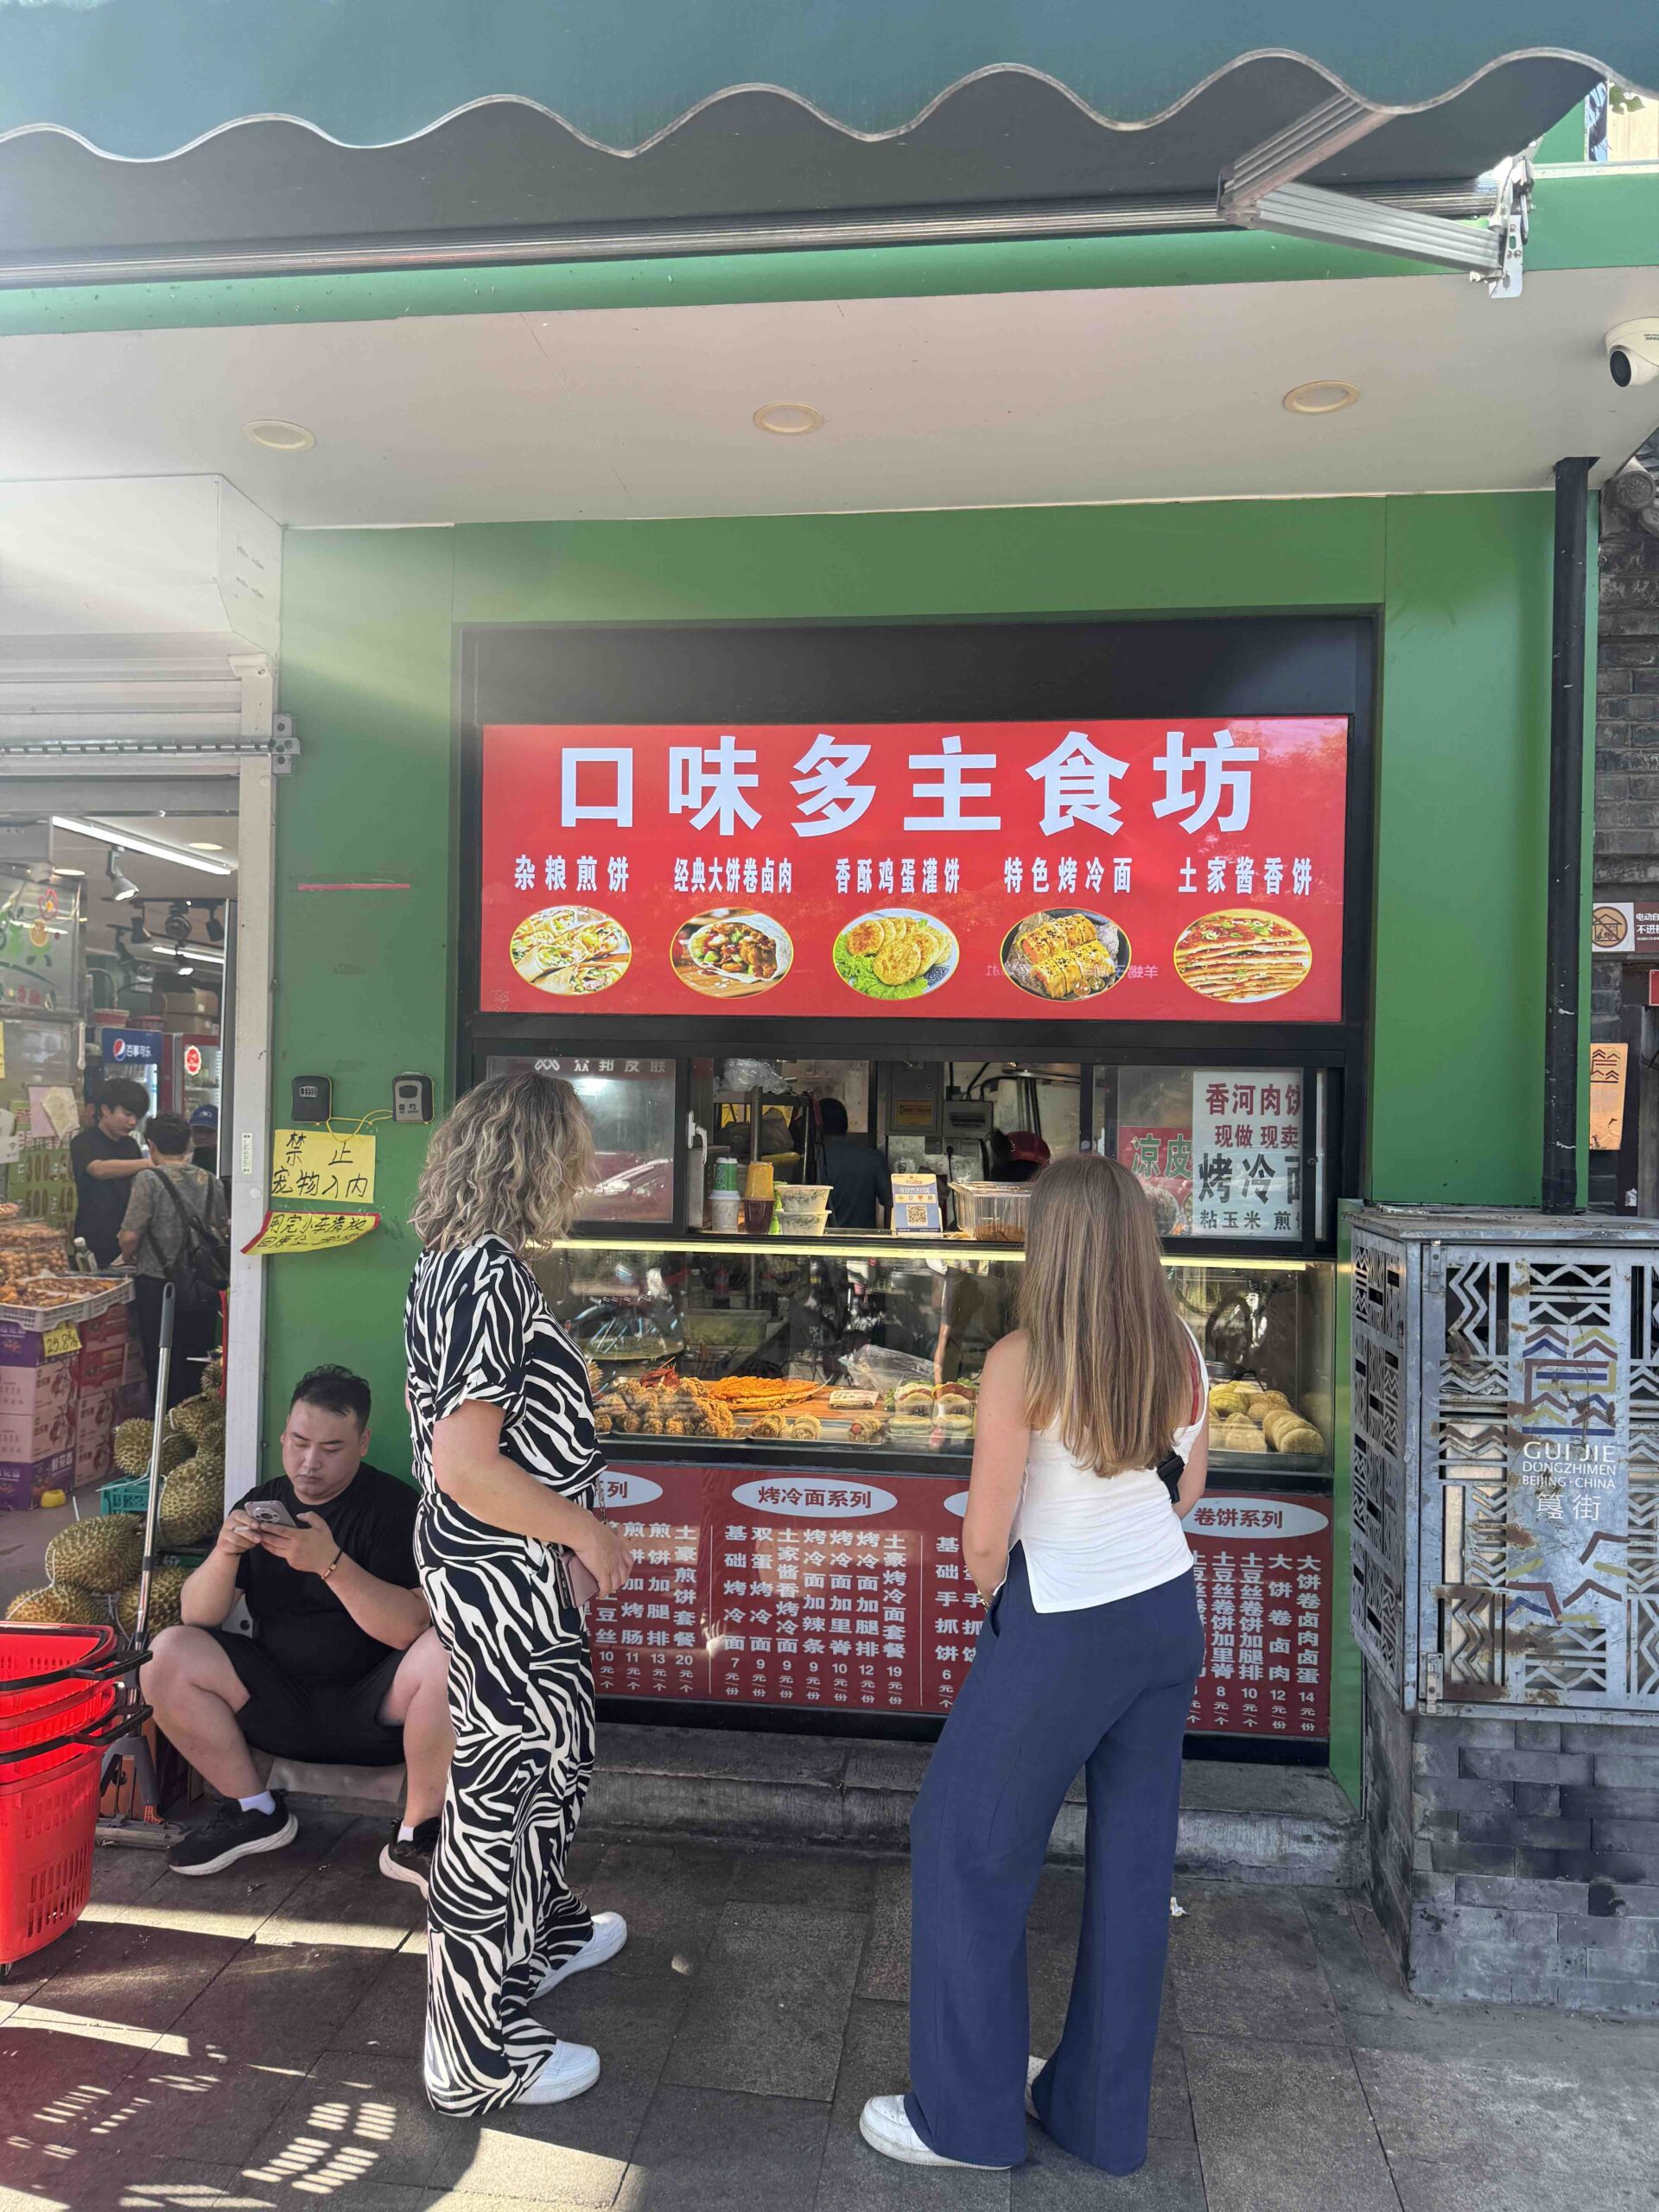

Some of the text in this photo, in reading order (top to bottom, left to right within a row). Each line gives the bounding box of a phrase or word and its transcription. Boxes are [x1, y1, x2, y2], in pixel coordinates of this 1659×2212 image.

[562, 730, 1260, 837] 口味多主食坊
[514, 854, 629, 892] 杂粮煎饼
[674, 856, 792, 894] 经典大饼卷卤肉
[836, 856, 960, 894] 香酥鸡蛋灌饼
[1003, 856, 1132, 894] 特色烤冷面
[1179, 856, 1313, 895] 土家酱香饼
[1636, 924, 1659, 935] 不进
[126, 1044, 151, 1058] 百事可乐
[286, 1133, 354, 1166] 禁止
[1130, 1133, 1192, 1179] 凉皮
[271, 1166, 368, 1199] 宠物入内
[1199, 1210, 1300, 1230] 粘玉米 煎
[1522, 1461, 1616, 1476] DONGZHIMEN
[1523, 1440, 1616, 1463] GUI JIE
[758, 1485, 872, 1509] 烤冷面系列
[1522, 1475, 1616, 1489] BEIJING CHINA
[1194, 1507, 1283, 1529] 卷饼系列
[1536, 1491, 1602, 1521] 簋街
[647, 1522, 671, 1646] 煎饼加腿排
[672, 1524, 696, 1648] 土豪煎饼套餐
[723, 1524, 747, 1651] 基础烤冷面
[750, 1526, 773, 1653] 双蛋烤冷面
[776, 1527, 800, 1654] 土家酱香烤冷面
[803, 1528, 826, 1655] 烤冷面加辣条
[829, 1529, 853, 1656] 烤冷面加里脊
[855, 1530, 880, 1657] 烤冷面加腿排
[882, 1534, 907, 1659] 土豪烤冷面套餐
[935, 1535, 959, 1662] 基础手抓饼
[1211, 1550, 1236, 1680] 土豆丝卷饼加里脊
[1239, 1552, 1264, 1681] 土豆丝卷饼加腿排
[1268, 1553, 1293, 1681] 大饼卷卤肉
[1296, 1554, 1321, 1684] 大饼卷卤肉卤蛋
